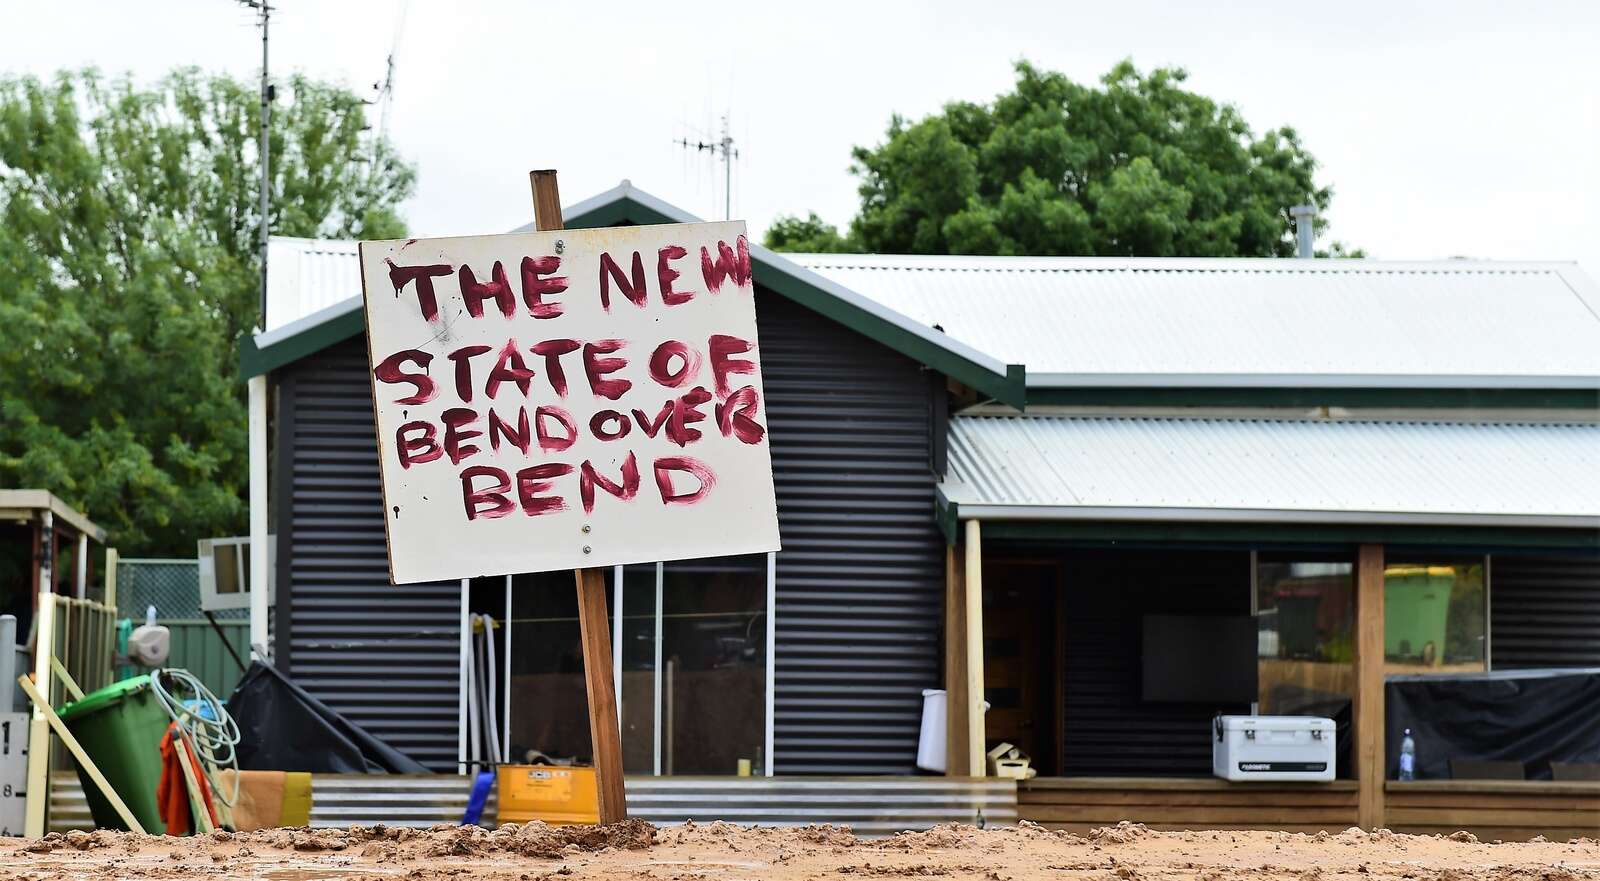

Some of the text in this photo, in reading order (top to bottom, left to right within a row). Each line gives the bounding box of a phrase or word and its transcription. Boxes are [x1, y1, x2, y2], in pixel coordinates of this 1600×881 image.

[384, 235, 752, 324] THE NEW
[374, 335, 756, 405] STATE OF
[396, 385, 766, 470] BEND OVER
[460, 450, 719, 520] BEND
[3, 784, 12, 798] 8
